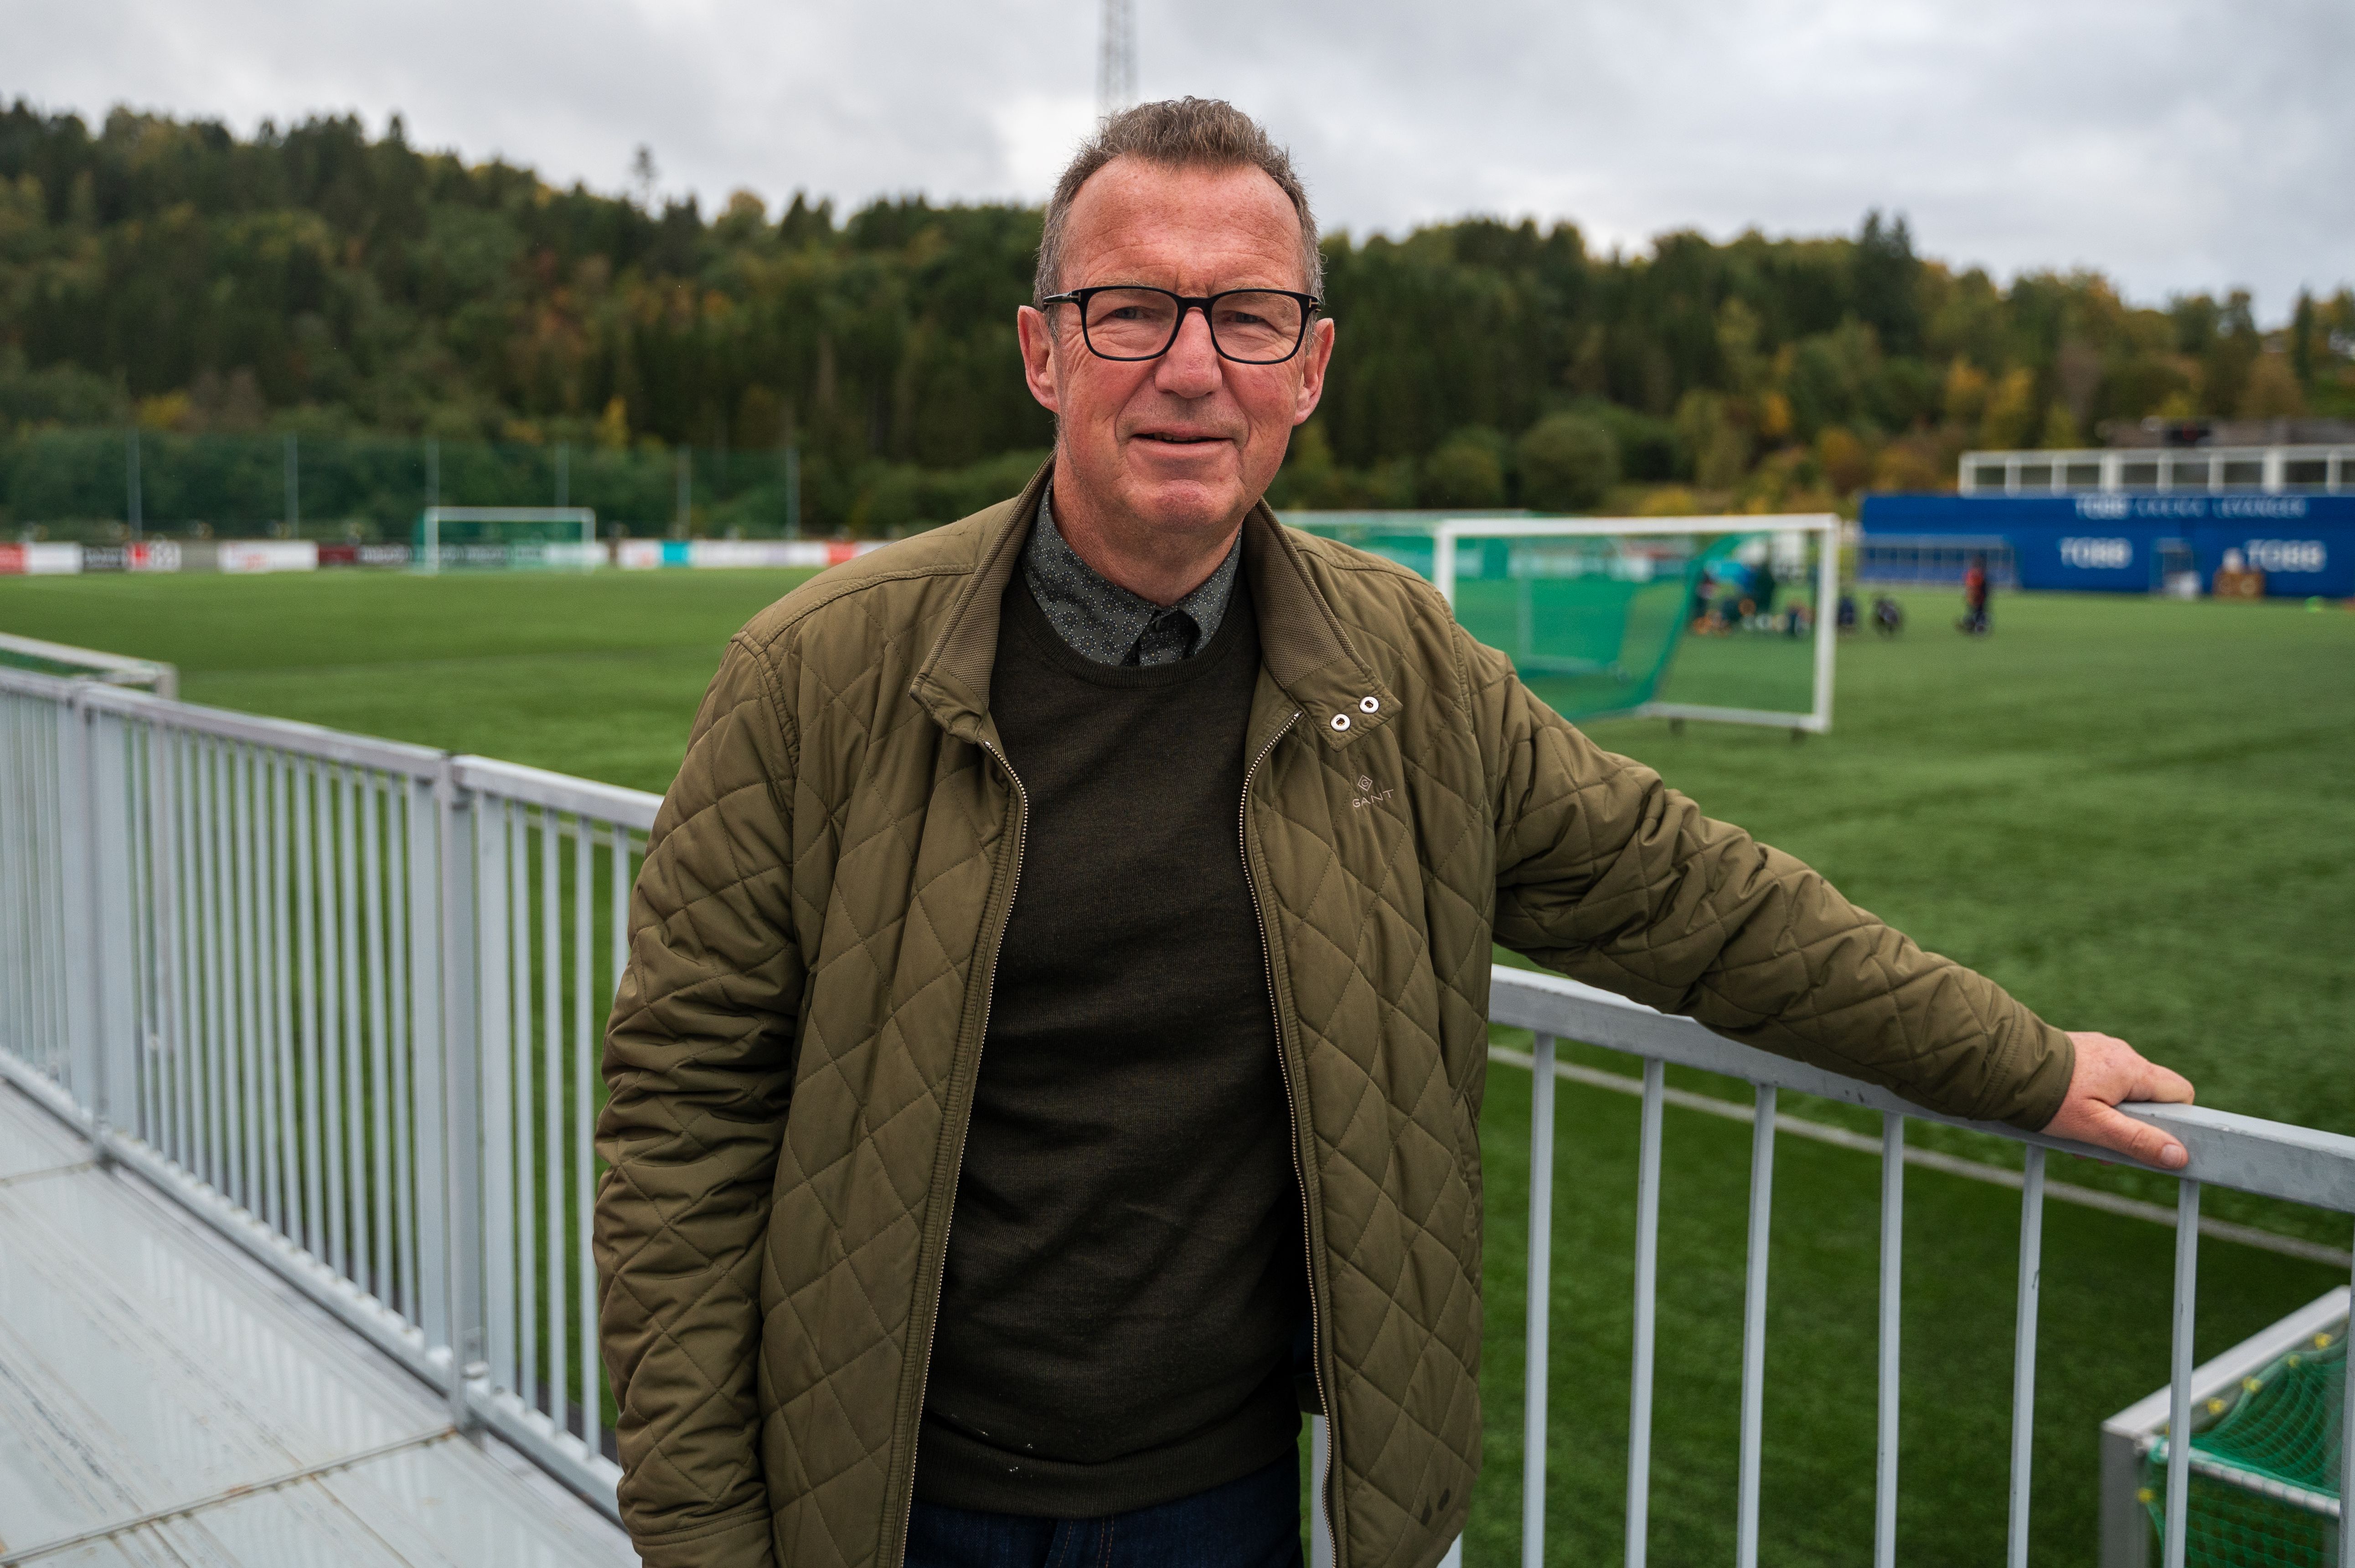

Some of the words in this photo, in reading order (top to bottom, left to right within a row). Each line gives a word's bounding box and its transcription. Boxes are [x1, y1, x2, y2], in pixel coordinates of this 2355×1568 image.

[2060, 538, 2132, 568] TOBB
[2247, 540, 2325, 572] TOBB
[1352, 789, 1394, 808] GANT
